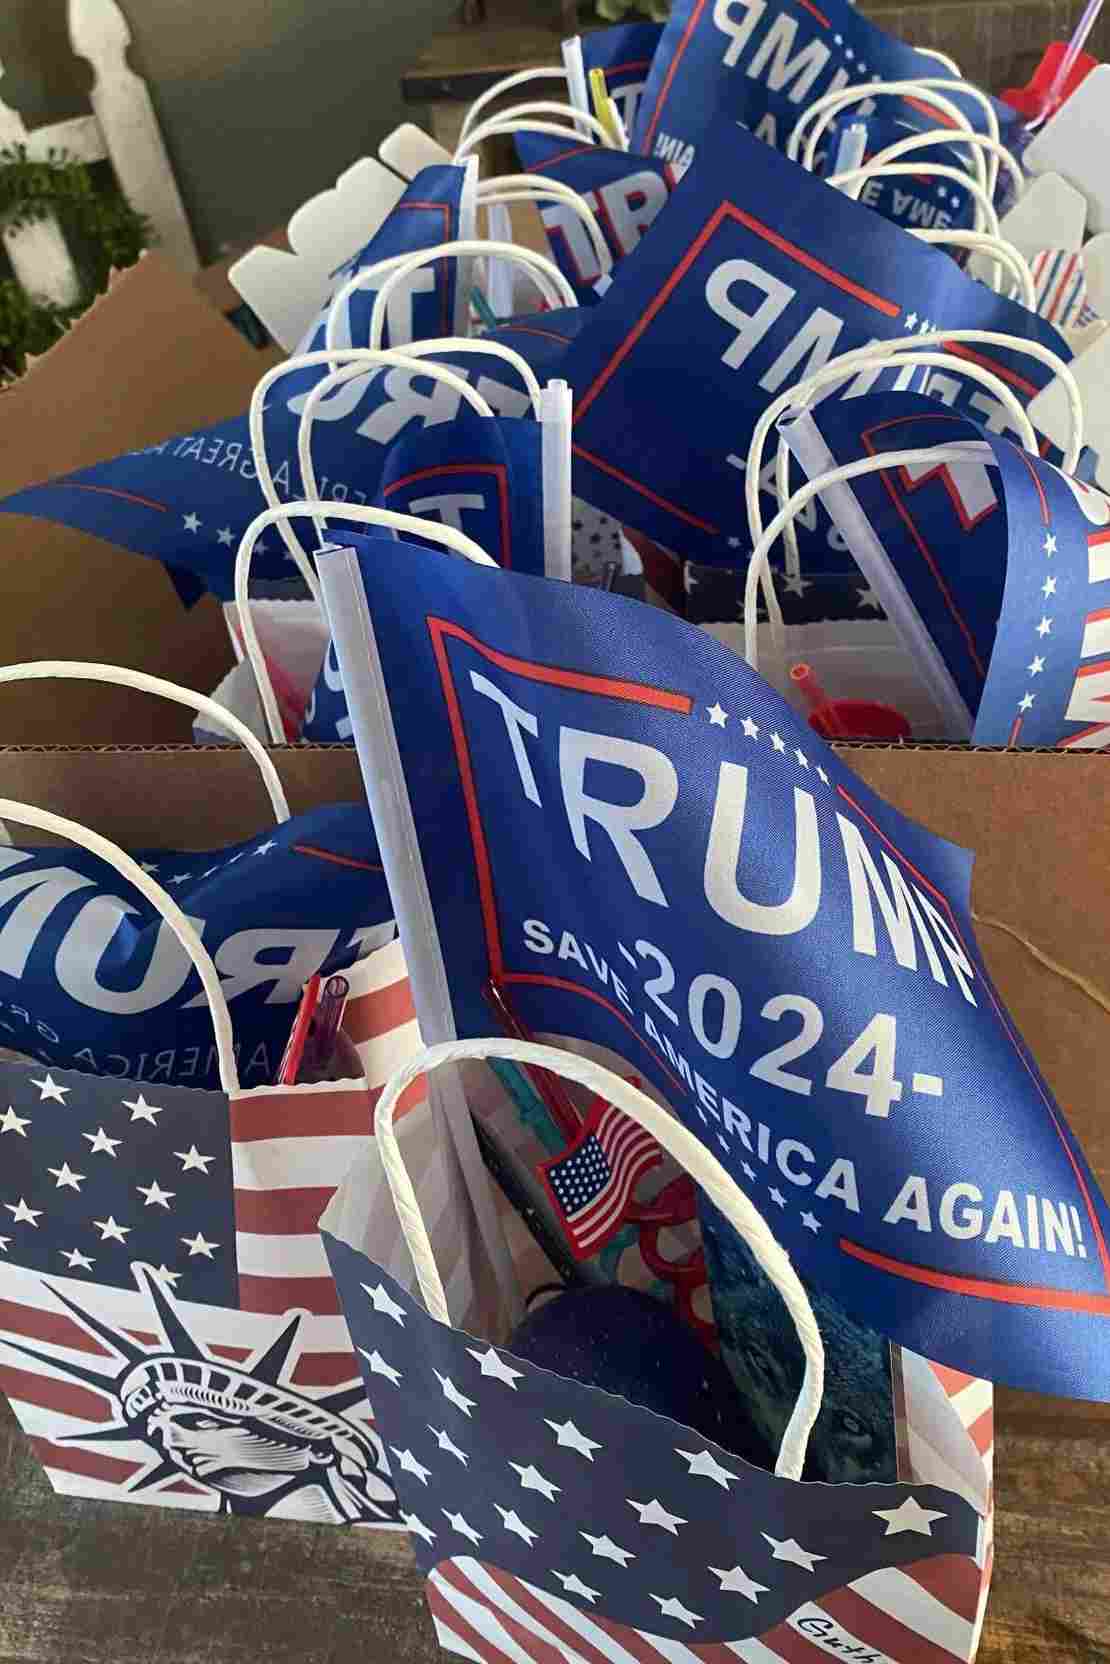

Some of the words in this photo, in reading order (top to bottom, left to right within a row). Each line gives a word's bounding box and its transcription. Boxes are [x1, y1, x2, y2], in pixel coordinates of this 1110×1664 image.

[469, 670, 977, 1008] TRUMP
[522, 919, 634, 1015] SAVE
[644, 1012, 861, 1212] AMERICA
[884, 1175, 1088, 1258] AGAIN!
